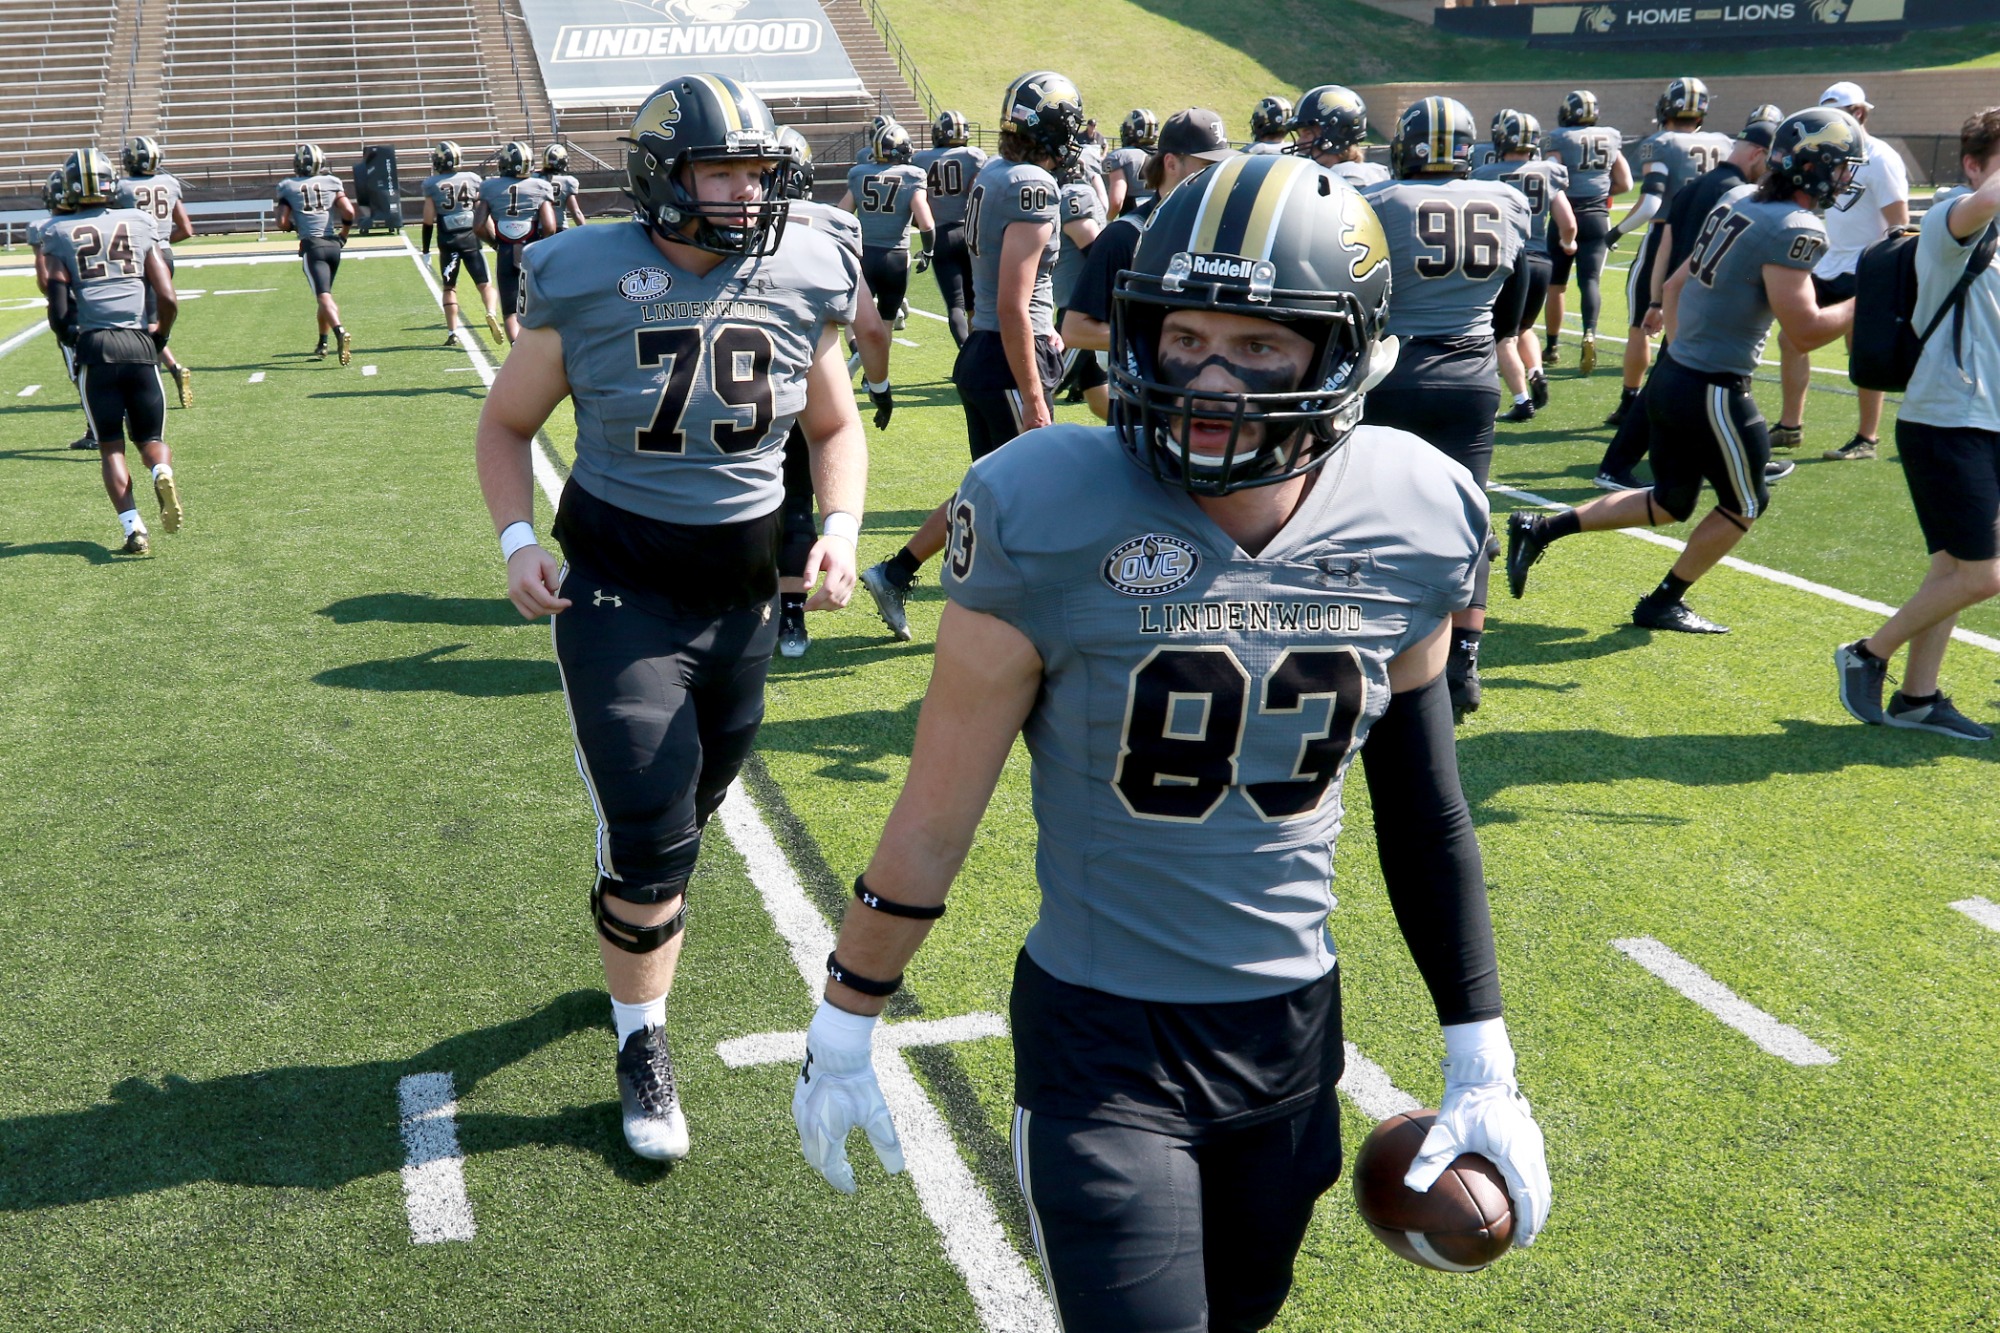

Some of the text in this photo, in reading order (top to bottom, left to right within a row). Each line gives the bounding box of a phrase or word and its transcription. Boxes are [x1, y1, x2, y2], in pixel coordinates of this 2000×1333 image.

[1626, 3, 1796, 25] HOME LIONS
[564, 22, 811, 59] LINDENWOOD
[1577, 134, 1611, 172] 15
[860, 174, 903, 215] 57
[927, 159, 963, 197] 40
[133, 184, 169, 221] 26
[300, 182, 328, 213] 11
[438, 181, 475, 212] 34
[505, 183, 519, 218] 1
[1018, 185, 1049, 212] 80
[70, 221, 138, 281] 24
[1415, 199, 1502, 282] 96
[1689, 203, 1755, 289] 87
[1787, 234, 1825, 262] 87
[628, 275, 661, 294] OVC
[1192, 255, 1253, 279] Riddell
[641, 301, 769, 322] LINDENWOOD
[634, 323, 777, 456] 79
[1121, 550, 1179, 582] OVC
[1139, 600, 1363, 634] LINDENWOOD
[1110, 644, 1368, 824] 83
